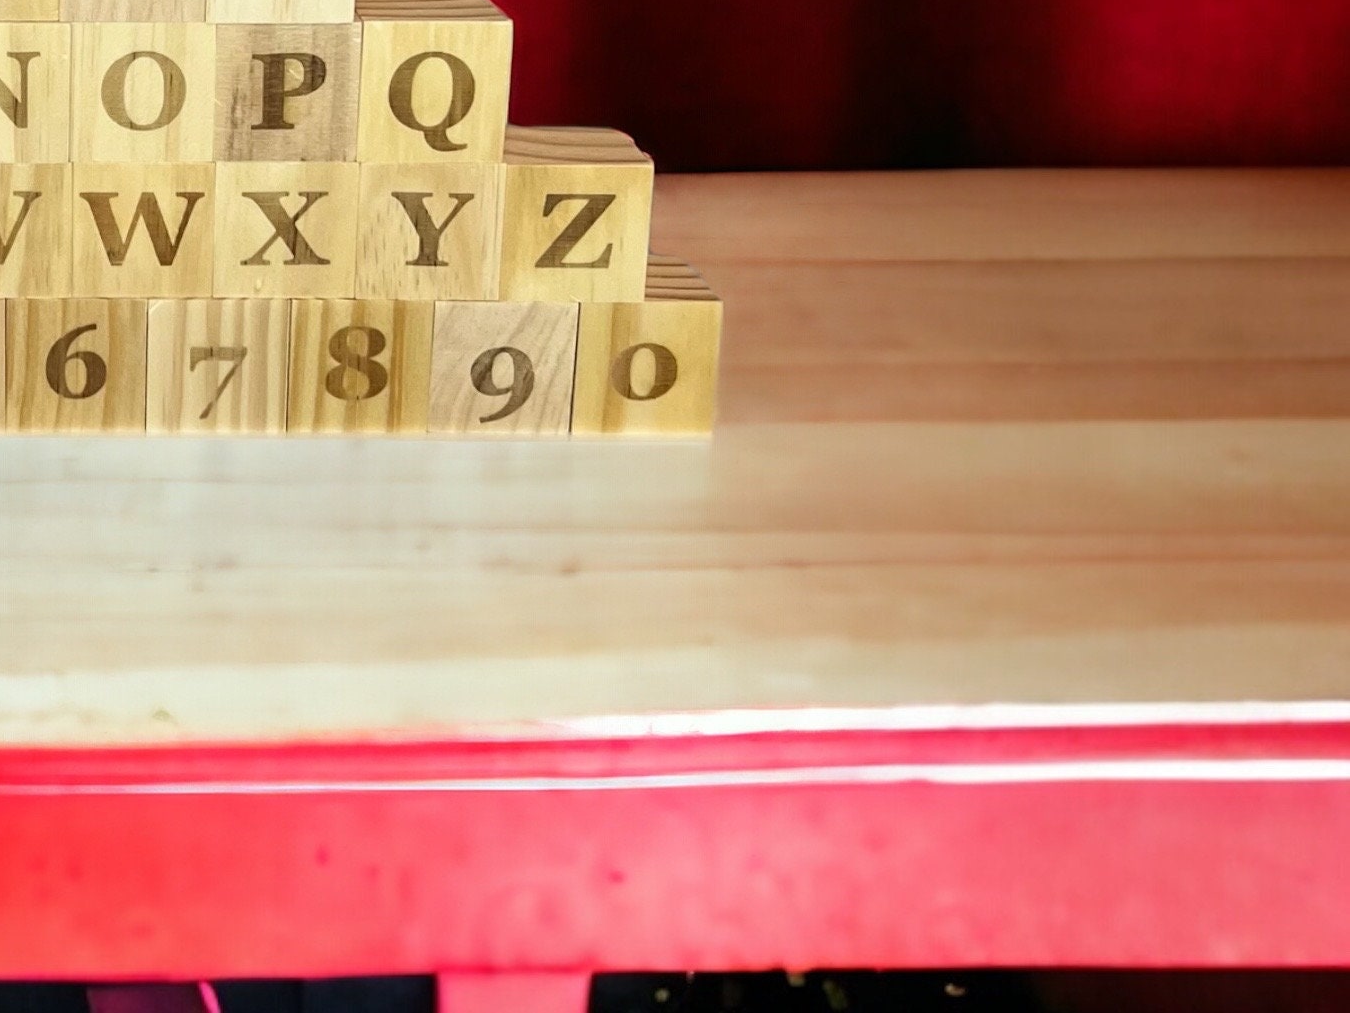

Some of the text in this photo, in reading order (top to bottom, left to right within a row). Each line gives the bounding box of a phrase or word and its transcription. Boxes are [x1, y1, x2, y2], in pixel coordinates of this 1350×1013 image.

[100, 50, 187, 131] O
[250, 52, 328, 130] P
[388, 51, 476, 152] Q
[79, 191, 205, 267] W
[241, 191, 331, 266] X
[391, 192, 475, 267] Y
[534, 193, 616, 269] Z
[45, 323, 107, 400] 6
[189, 346, 248, 420] 7
[324, 325, 388, 401] 8
[469, 346, 536, 423] 9
